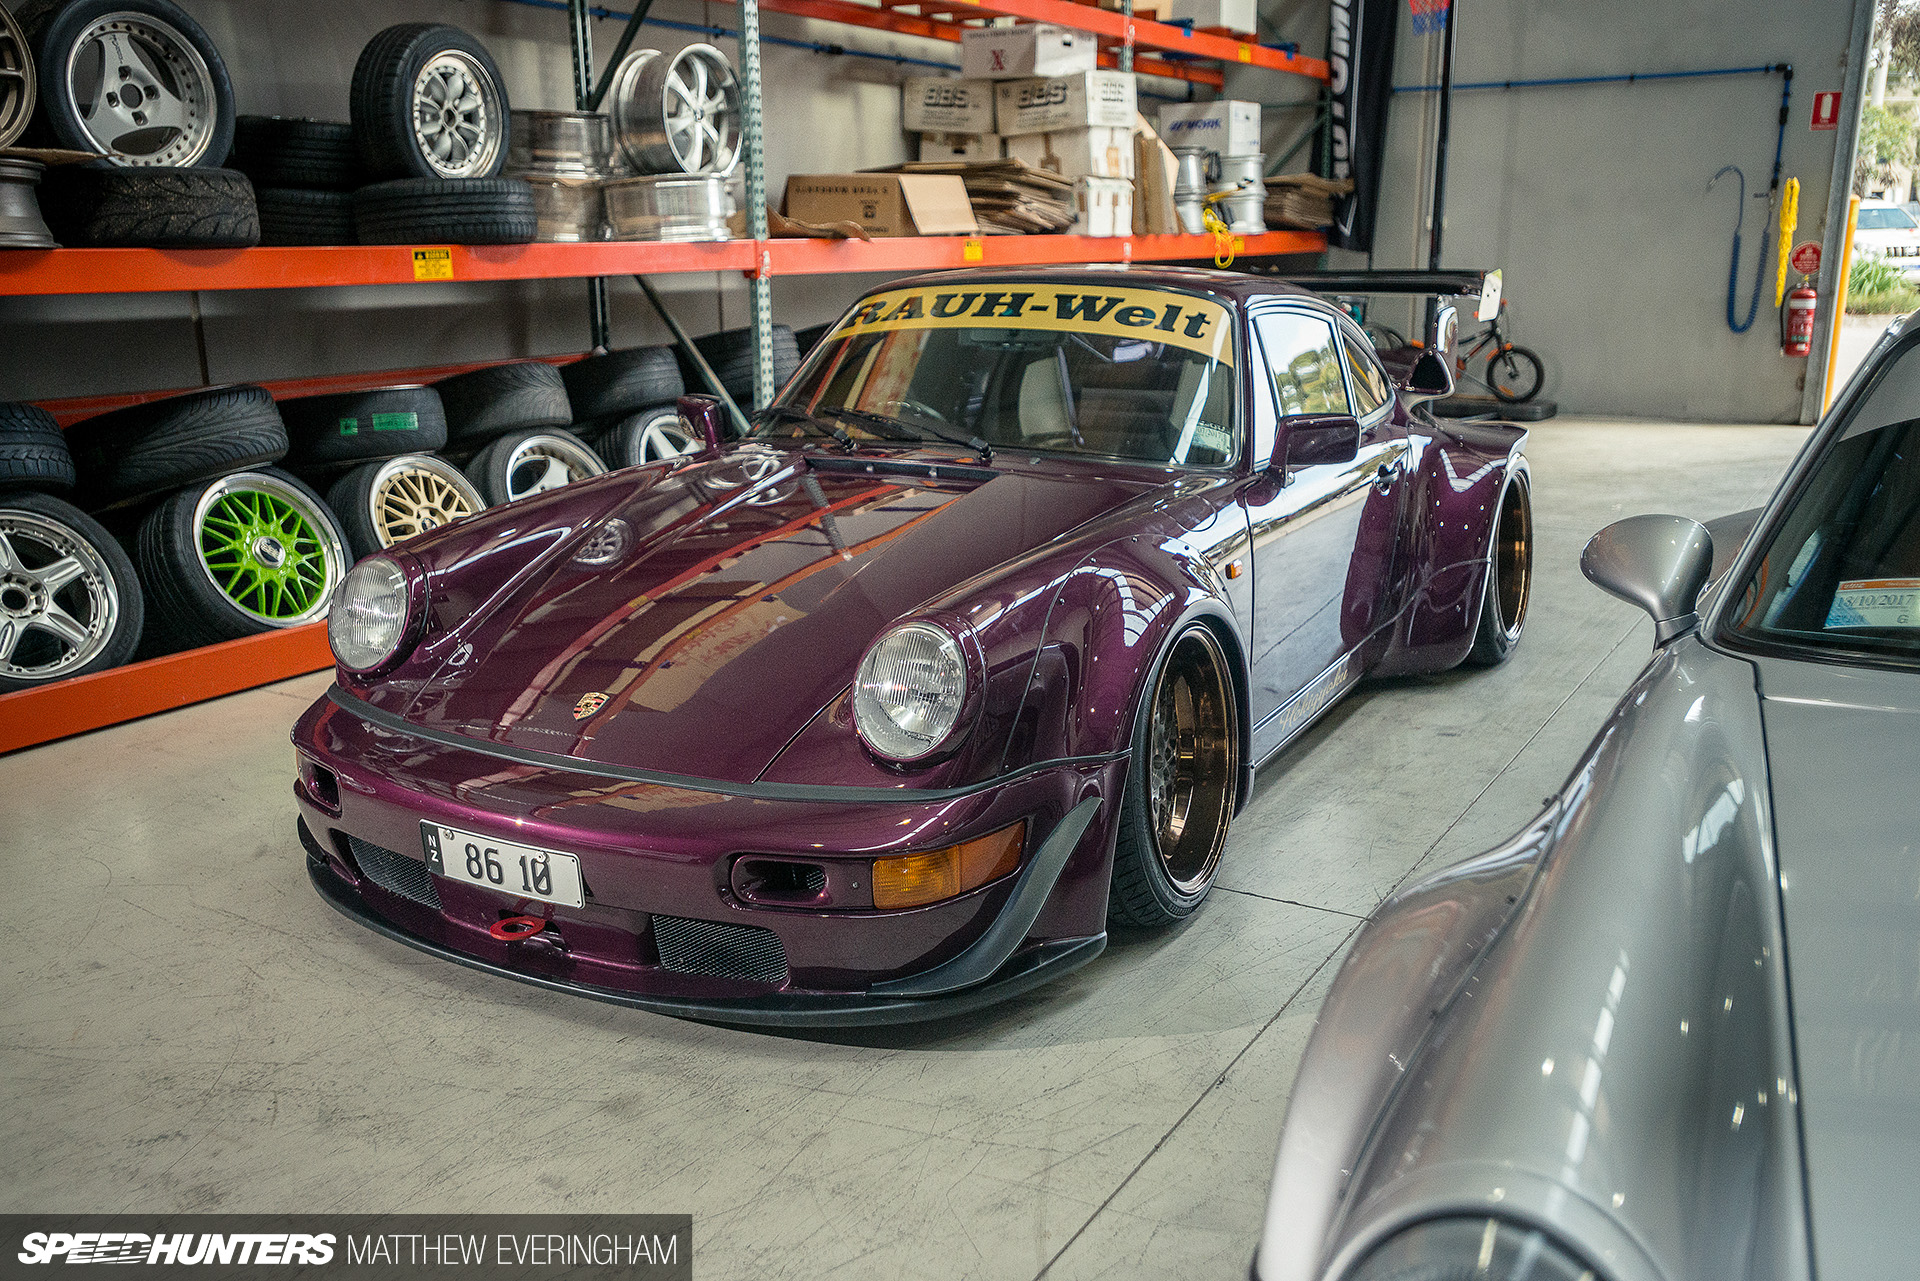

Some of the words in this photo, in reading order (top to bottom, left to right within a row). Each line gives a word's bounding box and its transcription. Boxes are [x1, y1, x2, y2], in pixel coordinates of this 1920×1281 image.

[924, 86, 969, 109] BBS
[1018, 80, 1068, 109] BBS
[842, 291, 1212, 340] RAUH-Welt
[464, 842, 504, 885] 86
[518, 853, 552, 896] 10
